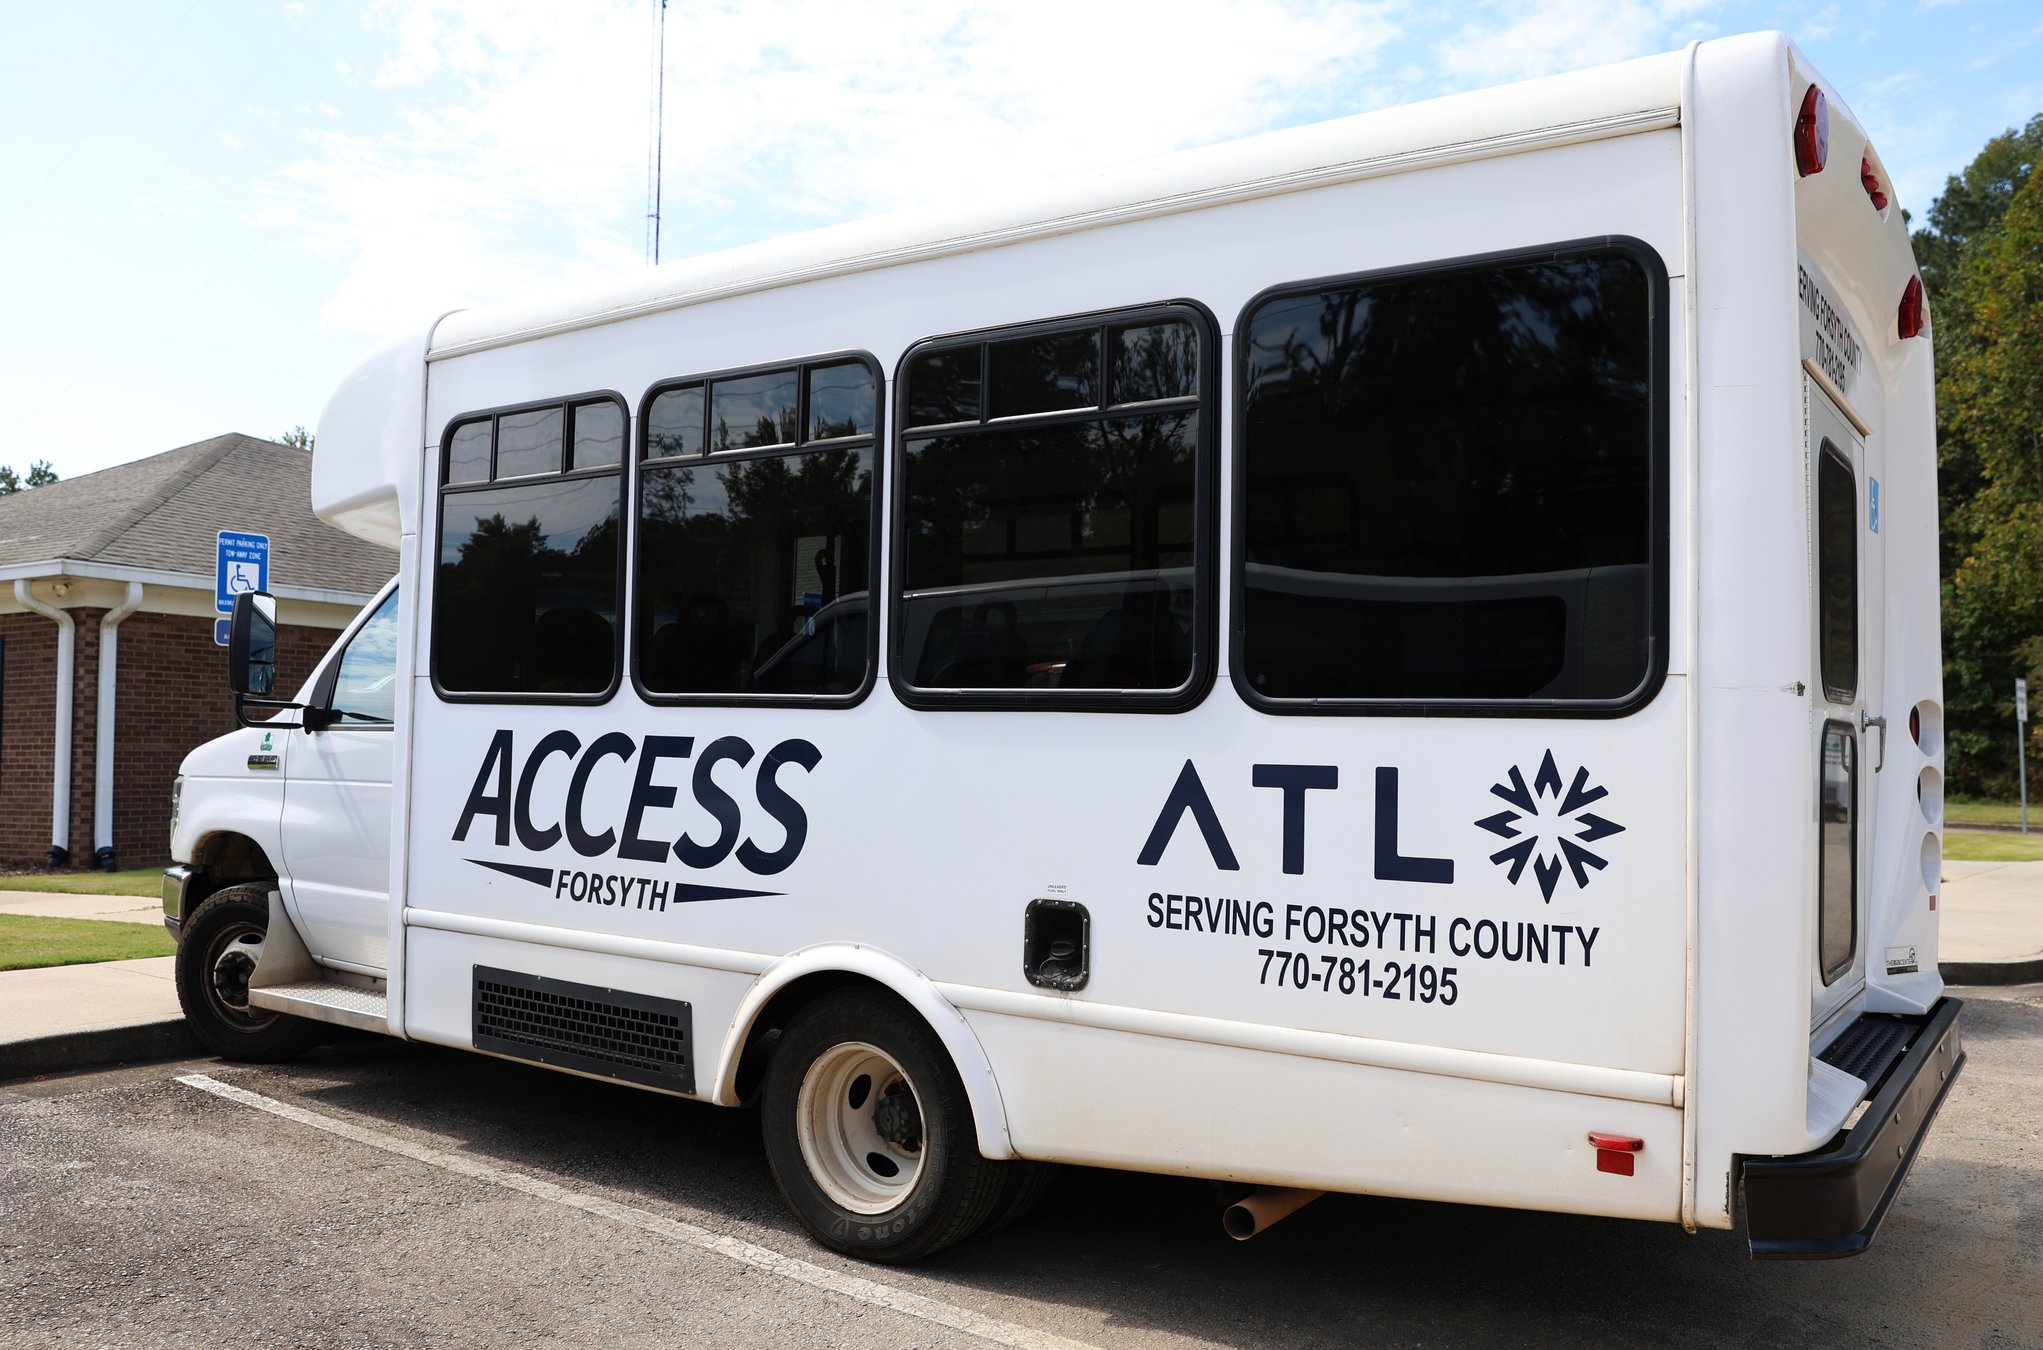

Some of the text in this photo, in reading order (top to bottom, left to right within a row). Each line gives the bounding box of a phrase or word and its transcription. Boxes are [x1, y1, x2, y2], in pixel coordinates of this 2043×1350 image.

[1798, 264, 1863, 377] ERVING FORSYTH COUNTY
[219, 537, 268, 550] PERMIT PARKING ONLY
[225, 549, 262, 560] TOW-AWAY ZONE
[451, 729, 823, 876] ACCESS
[1136, 758, 1455, 885] ATL
[556, 869, 670, 912] FORSYTH
[1146, 892, 1600, 967] SERVING FORSYTH COUNTY
[1257, 948, 1459, 1006] 770-781-2195
